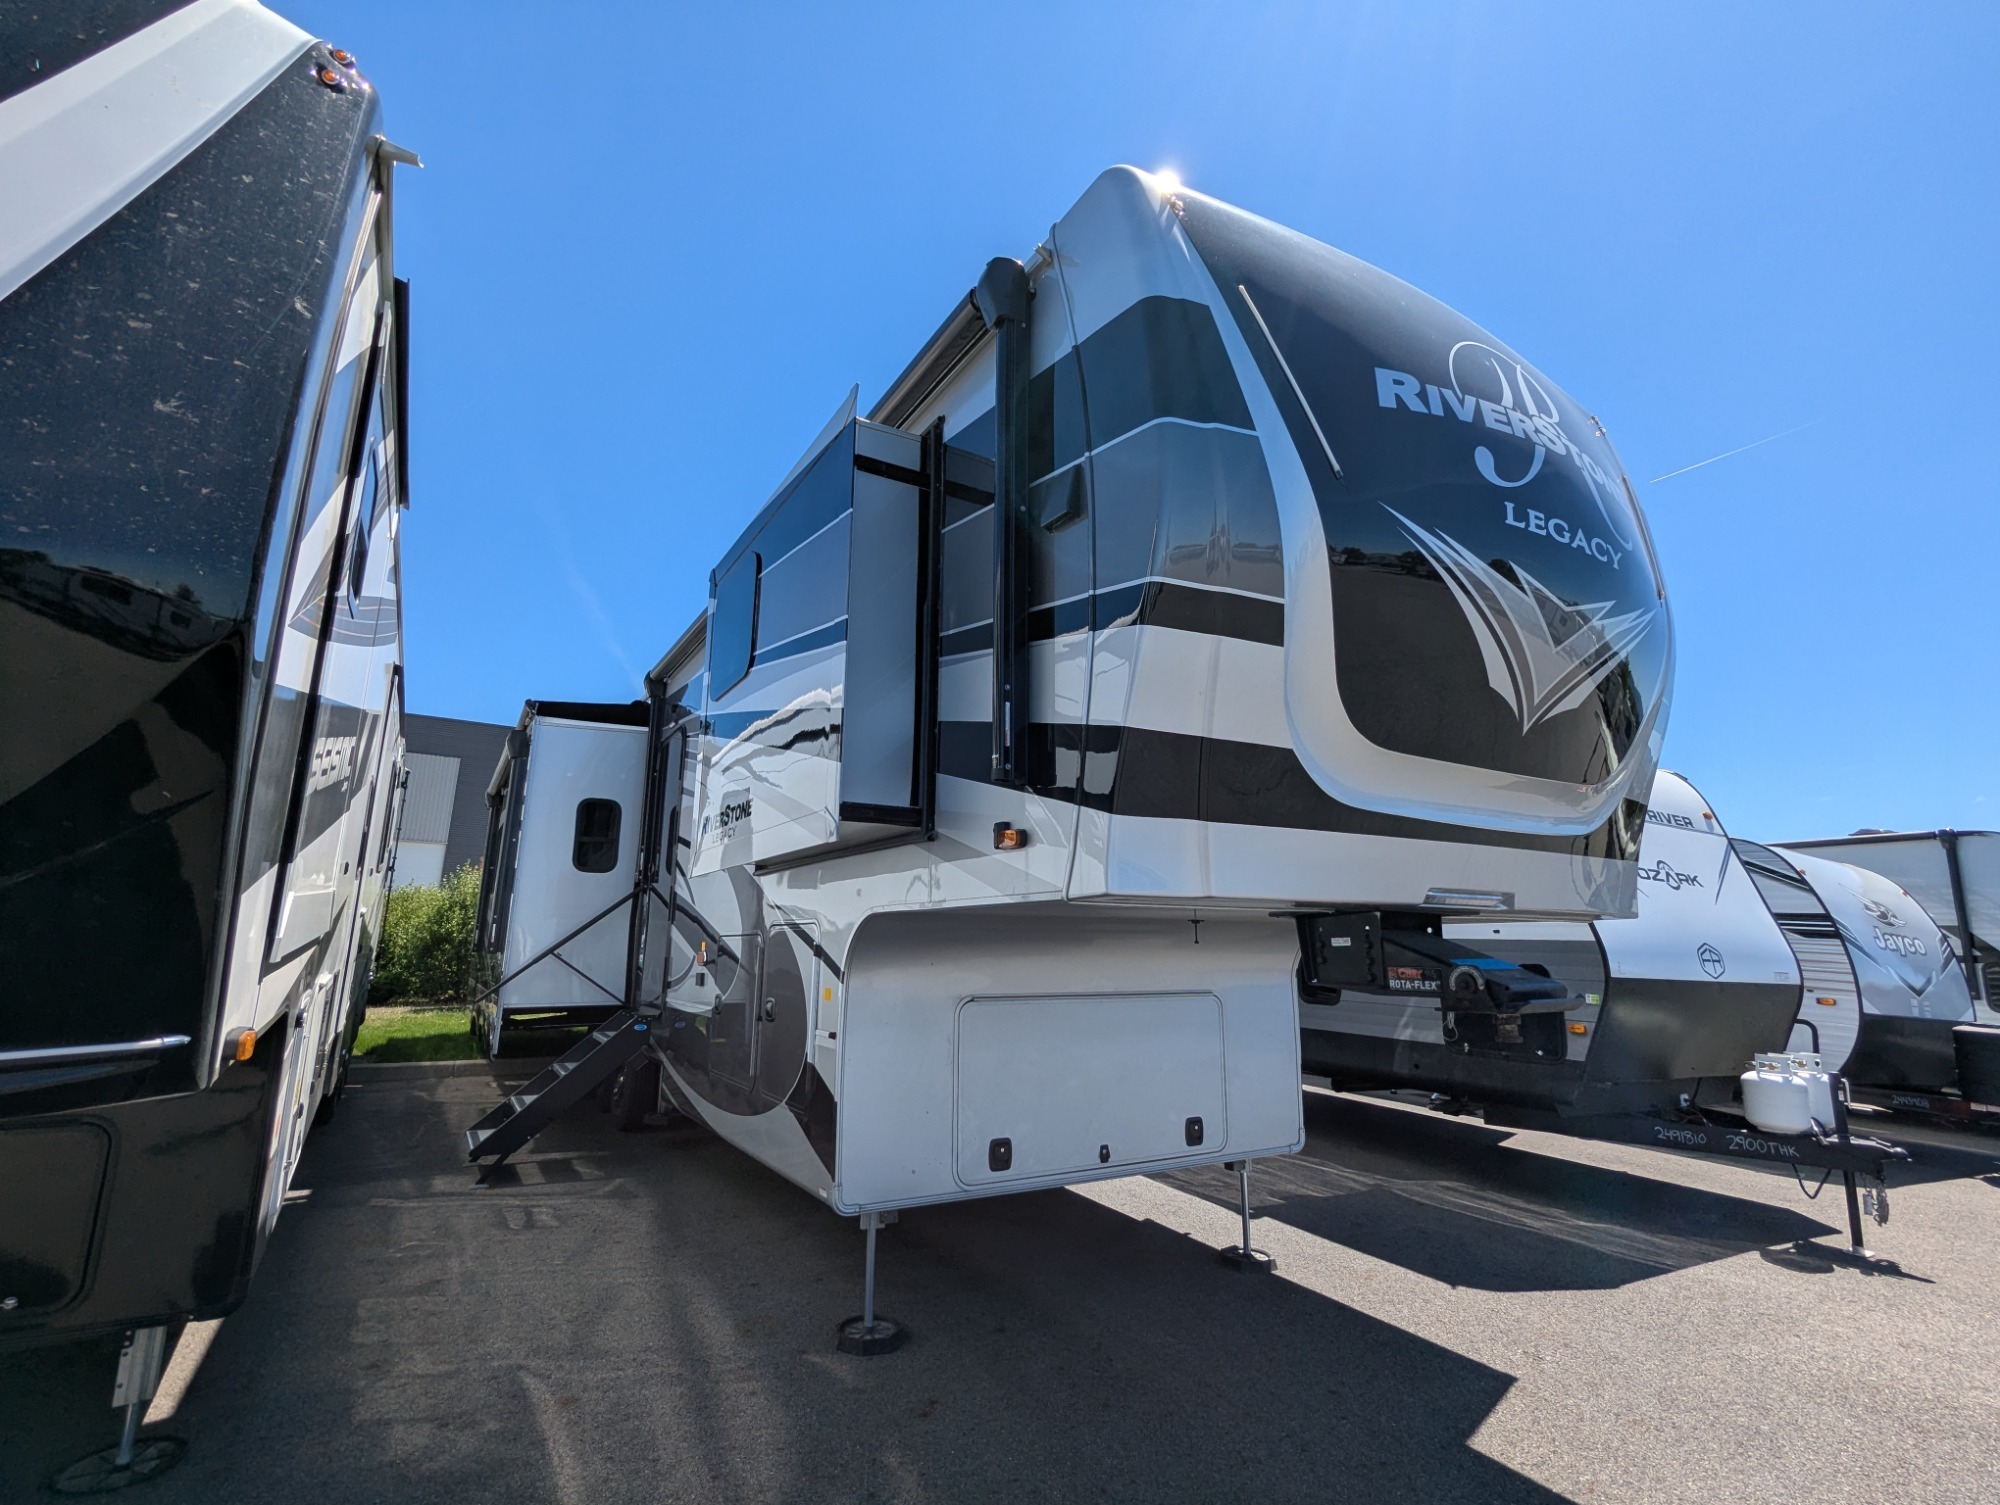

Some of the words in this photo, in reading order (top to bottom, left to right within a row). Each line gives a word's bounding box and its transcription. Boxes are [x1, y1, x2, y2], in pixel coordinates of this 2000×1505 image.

[1504, 501, 1622, 570] LEGACY
[1647, 809, 1695, 829] RIVER
[1638, 860, 1704, 890] OZARK
[1873, 926, 1927, 957] Jayco
[1389, 979, 1440, 990] ROTA-FLEX
[1654, 1126, 1707, 1145] 2491810
[1726, 1135, 1800, 1158] 2900THK
